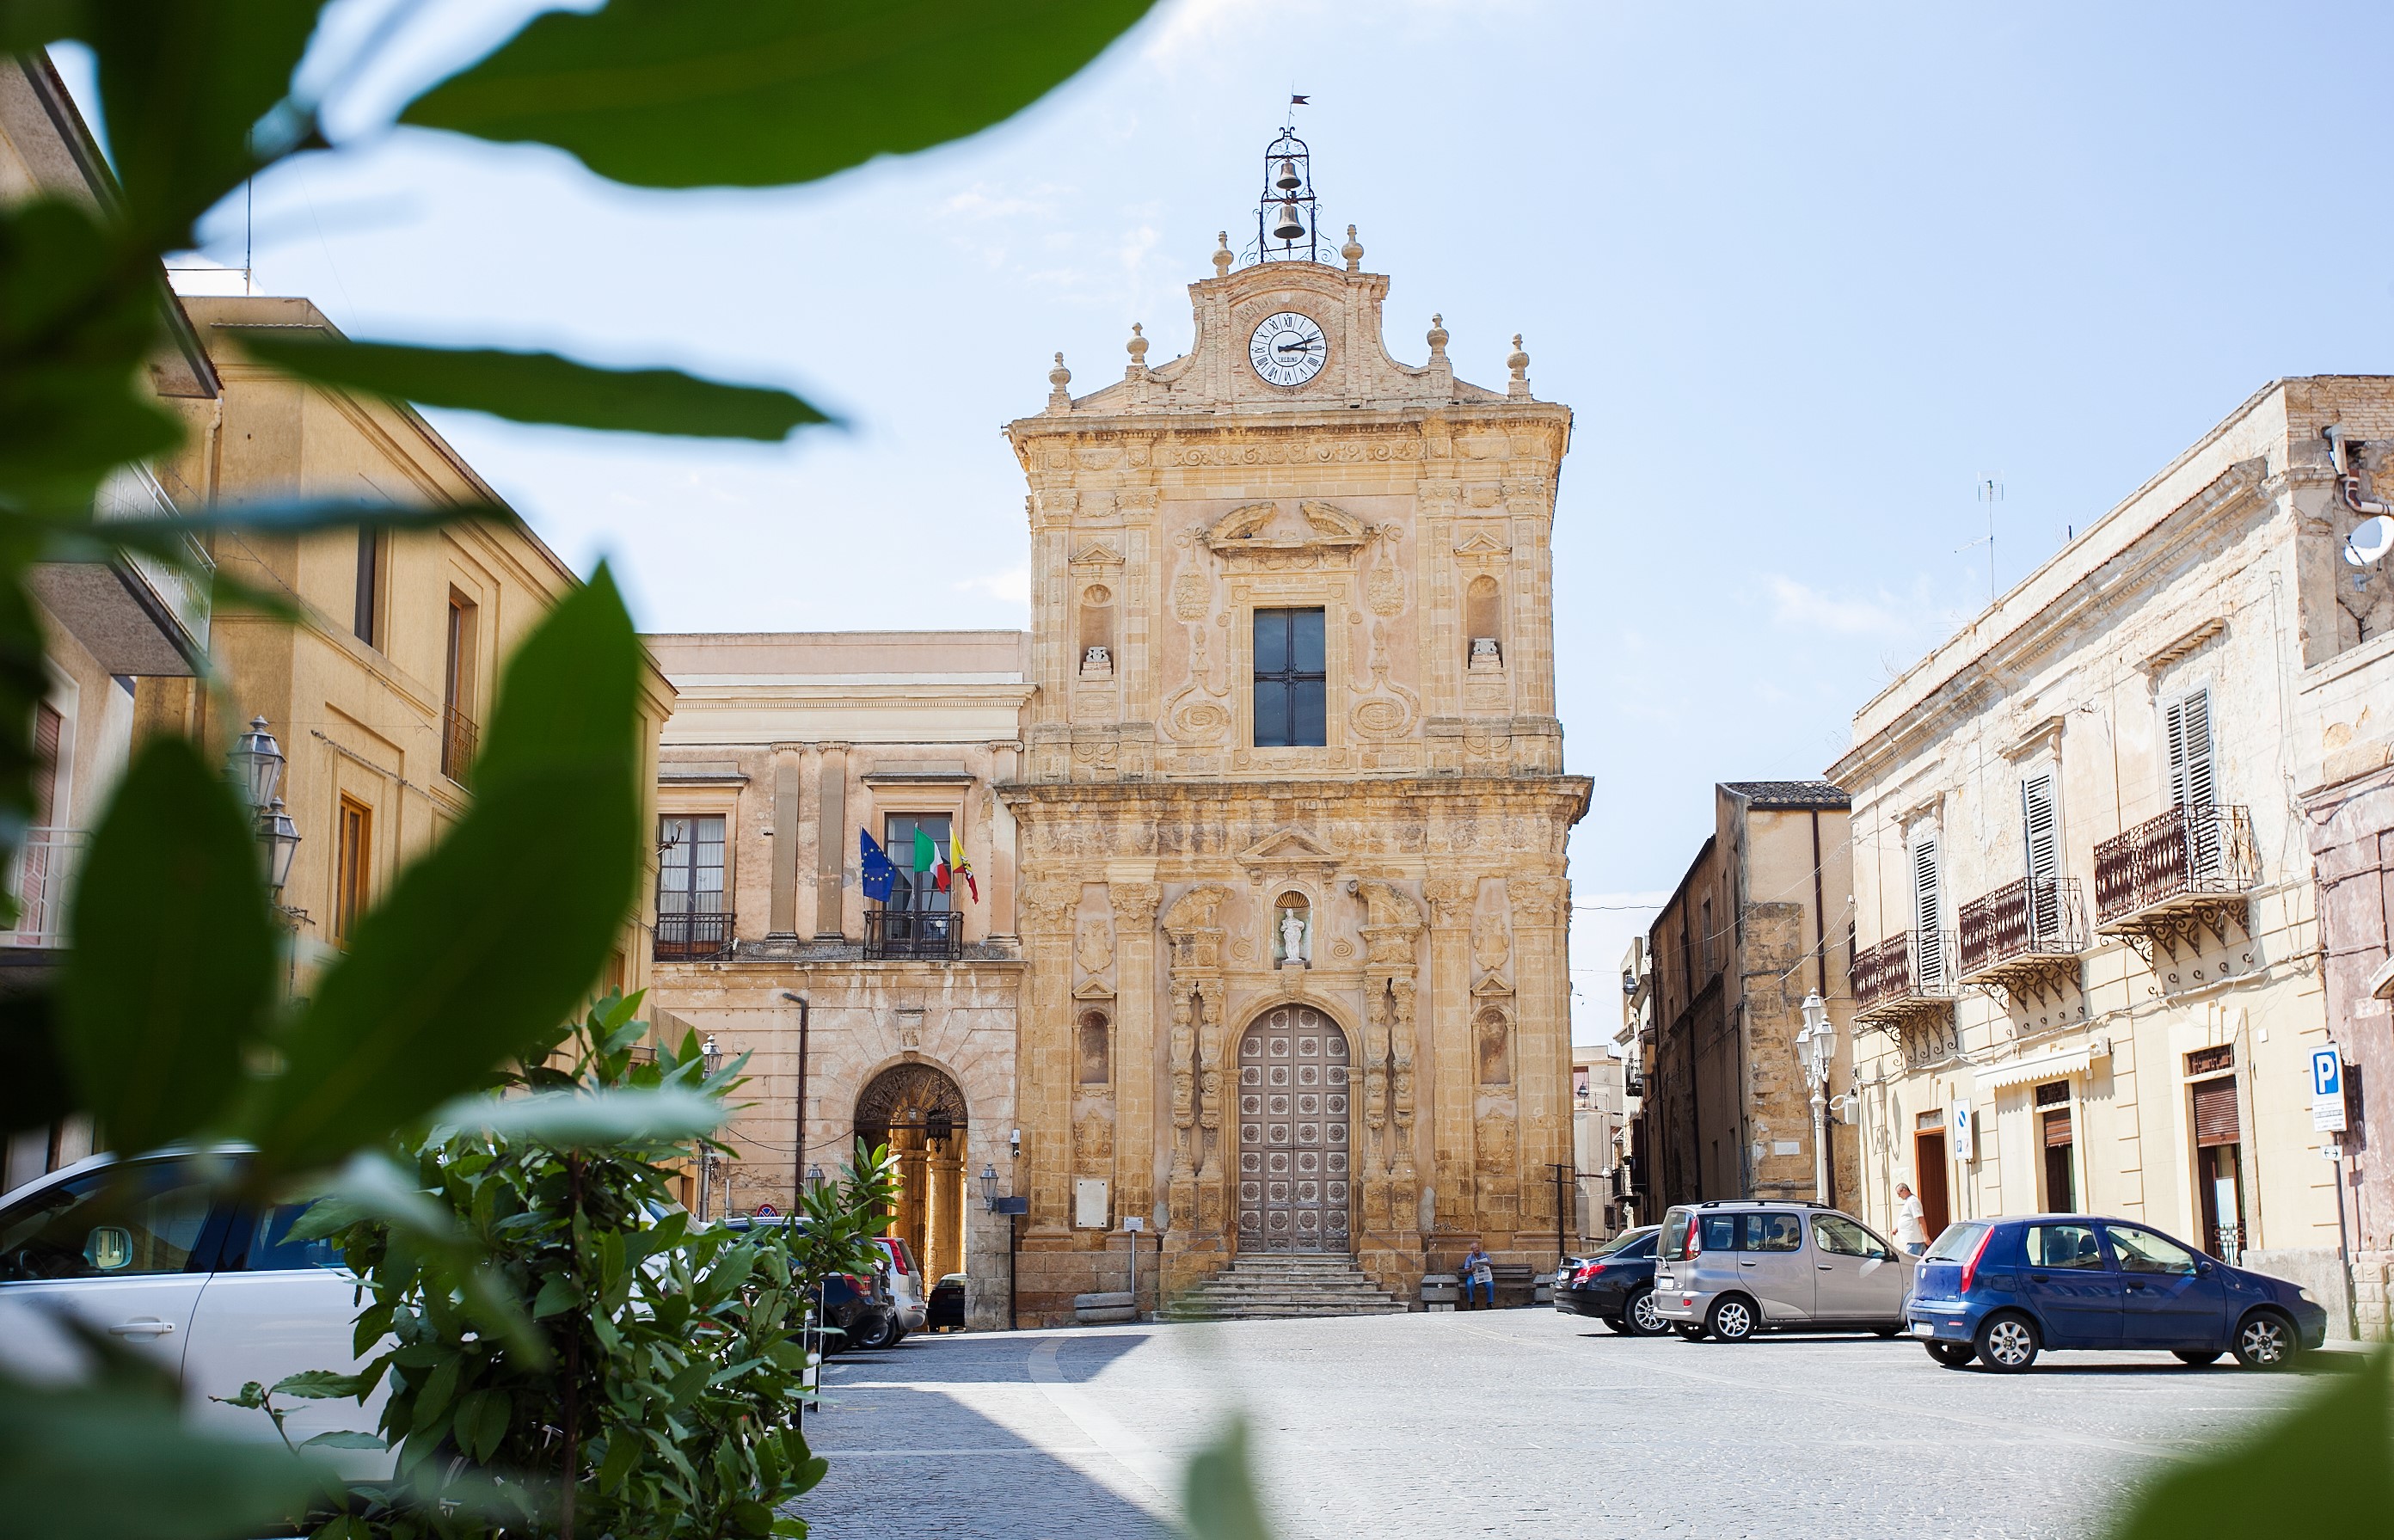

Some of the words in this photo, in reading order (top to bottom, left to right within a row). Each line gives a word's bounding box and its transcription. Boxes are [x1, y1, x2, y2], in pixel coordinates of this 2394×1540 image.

[1268, 321, 1279, 332] XI
[1258, 332, 1269, 341] X
[1257, 357, 1269, 370] VIII
[1268, 367, 1278, 379] VII
[1285, 371, 1292, 381] VI
[1299, 368, 1307, 377] V
[2316, 1055, 2336, 1094] P
